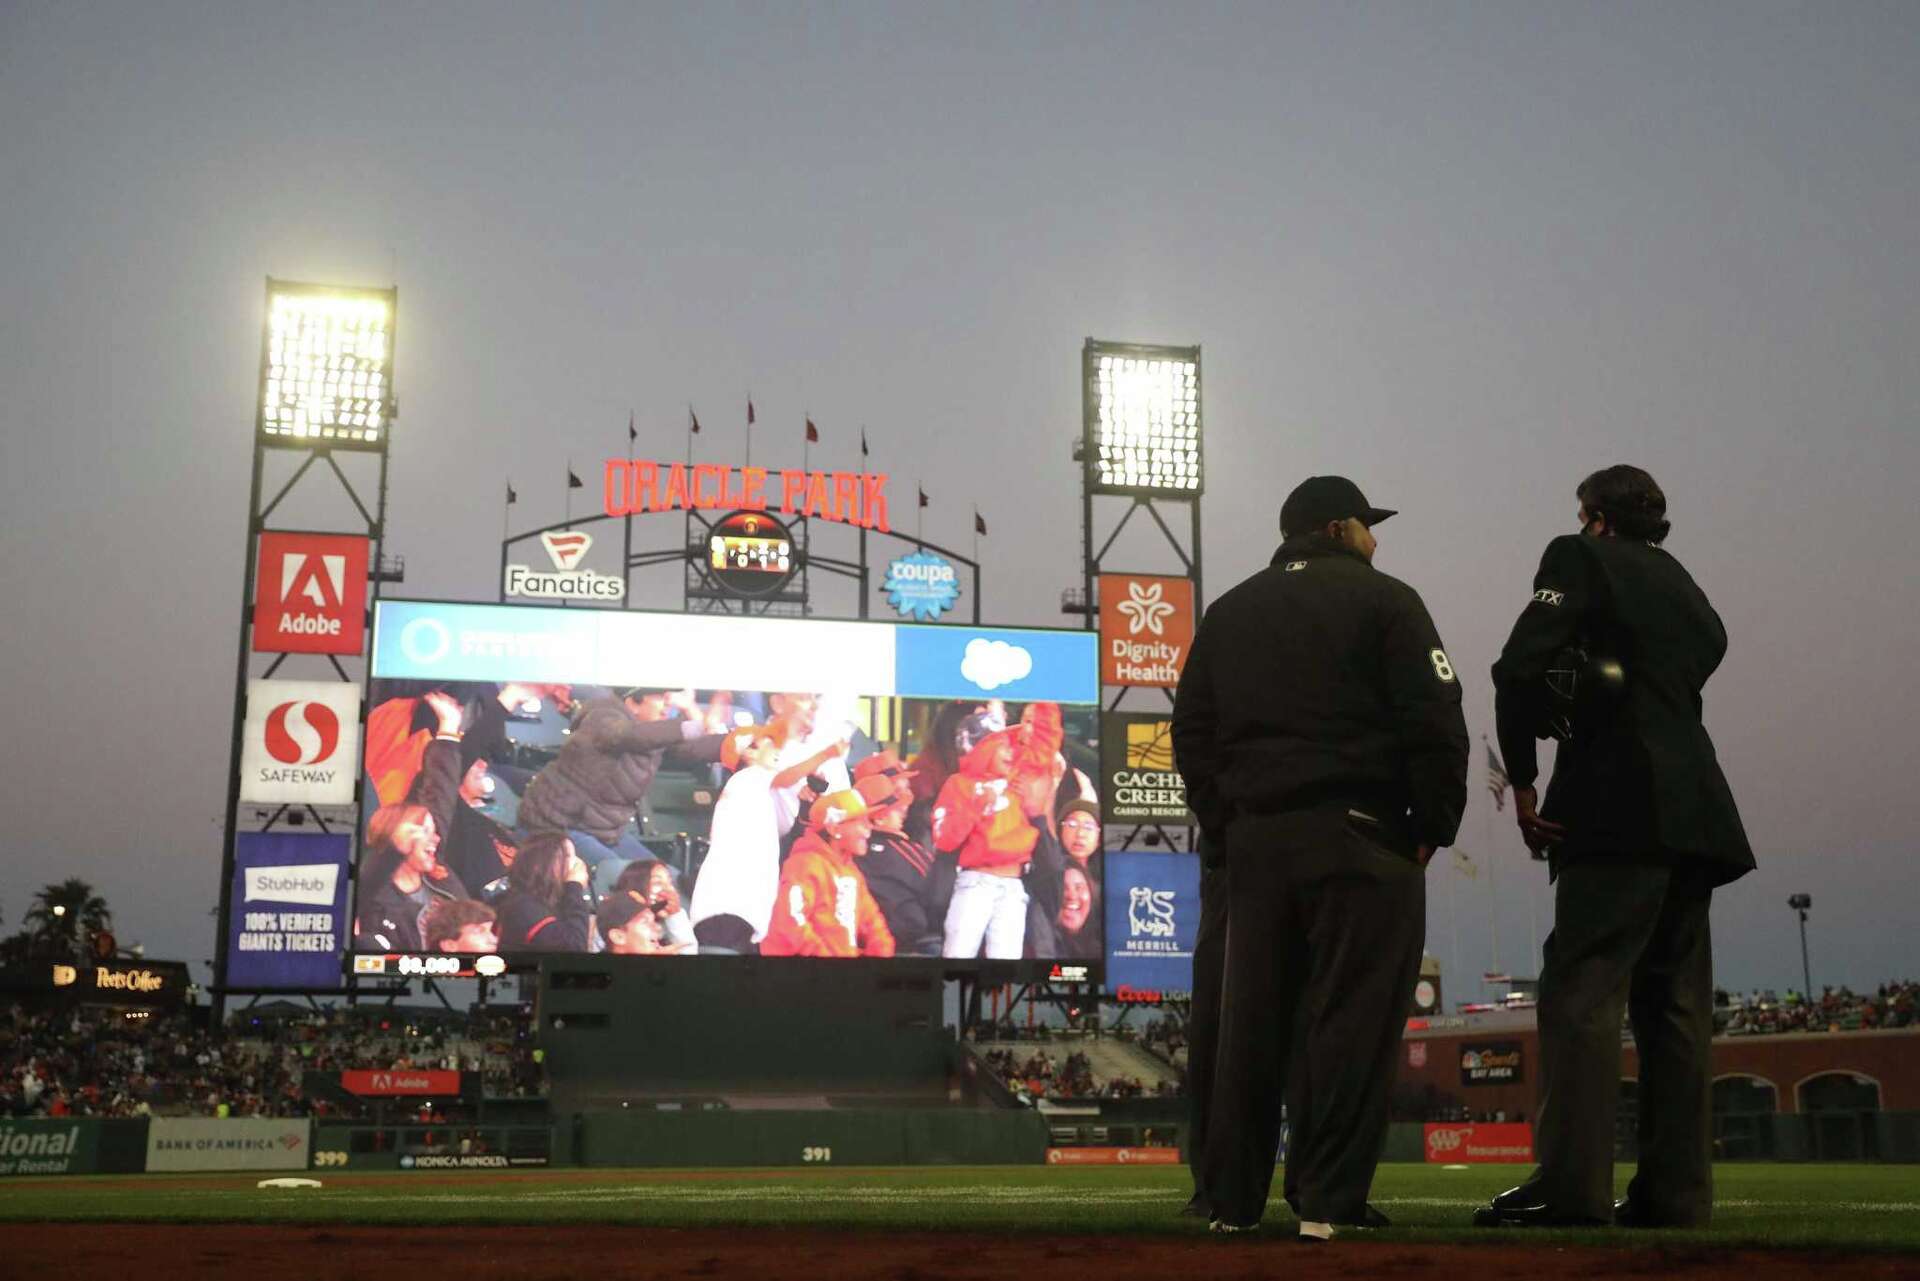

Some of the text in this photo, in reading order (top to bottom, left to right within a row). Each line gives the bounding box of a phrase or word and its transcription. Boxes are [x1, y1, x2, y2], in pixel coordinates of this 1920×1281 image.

[604, 458, 891, 534] ORACLE PARK
[510, 569, 621, 596] Fanatics
[892, 561, 954, 587] coupa
[278, 611, 342, 635] Adobe
[1112, 639, 1181, 666] Dignity
[1115, 662, 1179, 682] Health
[260, 768, 337, 784] SAFEWAY
[1115, 788, 1185, 805] CREEK
[1113, 807, 1188, 816] CASINO RESORT
[256, 876, 325, 891] StubHub
[244, 912, 333, 932] 100% VERIFIED
[238, 932, 336, 953] GIANTS TICKETS
[1126, 940, 1179, 951] MERRILL
[127, 970, 163, 992] Coffee
[1162, 991, 1192, 1002] LIGH
[0, 1126, 80, 1155] ional
[156, 1136, 275, 1150] BANK OF AMERICA
[314, 1150, 349, 1167] 399
[415, 1156, 459, 1167] KONICA
[459, 1155, 509, 1167] MINOLTA
[802, 1147, 831, 1162] 391
